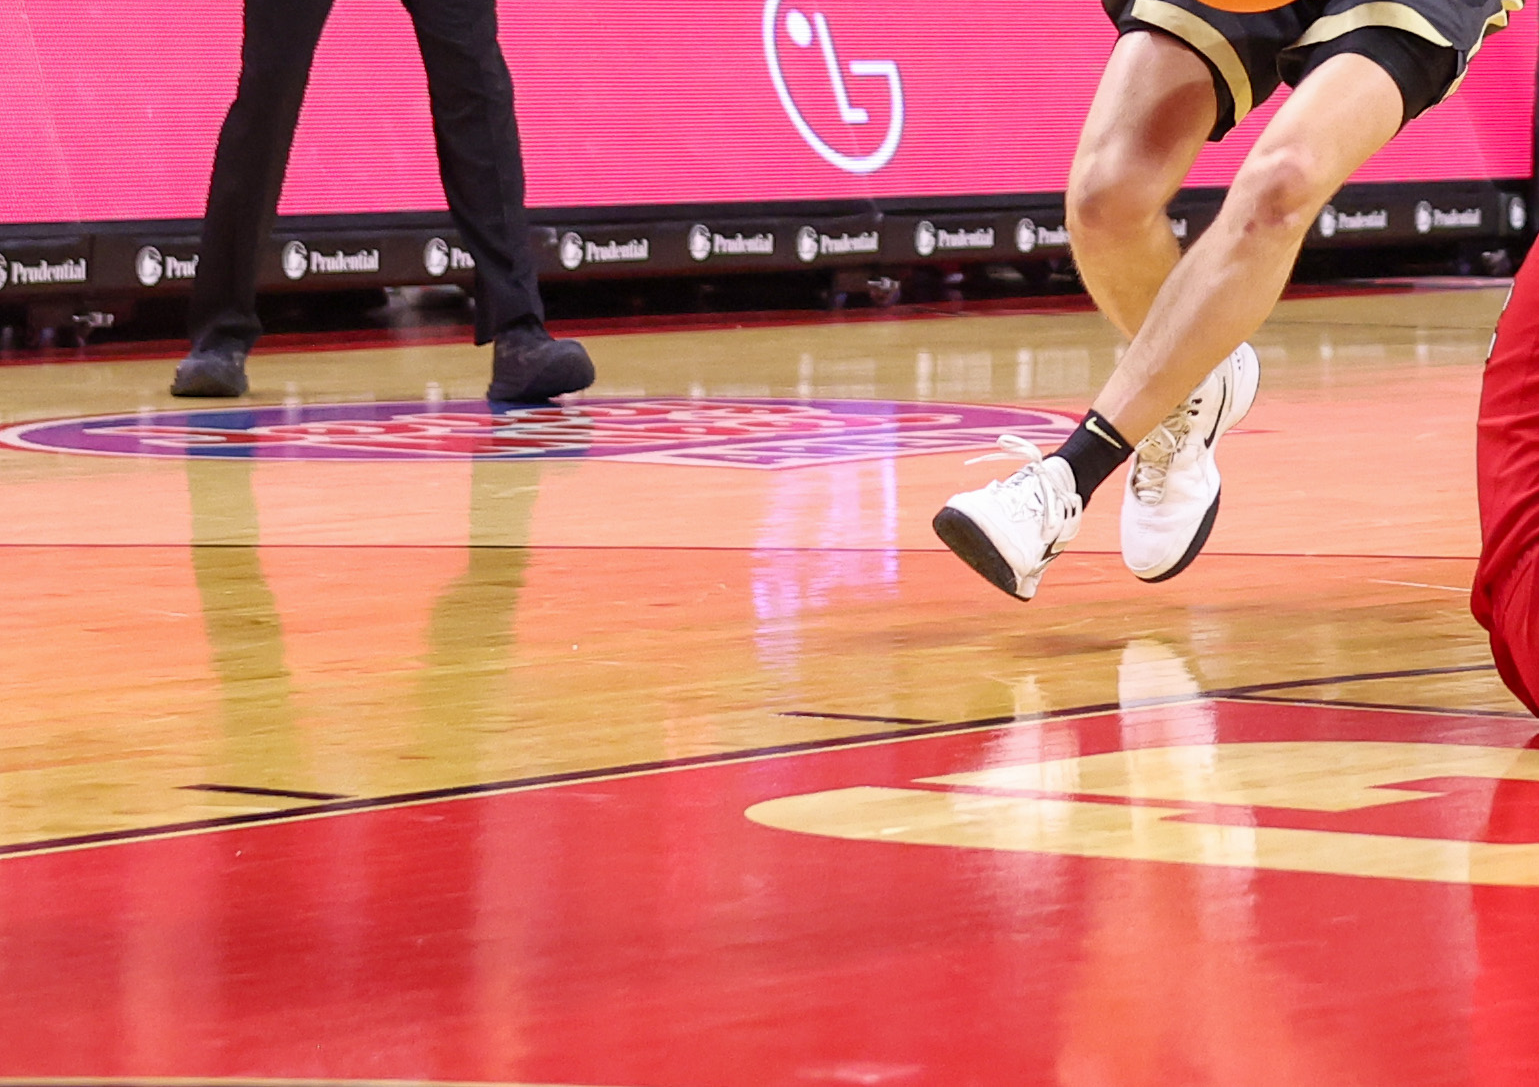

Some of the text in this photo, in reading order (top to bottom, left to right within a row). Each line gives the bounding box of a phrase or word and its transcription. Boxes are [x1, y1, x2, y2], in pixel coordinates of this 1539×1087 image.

[713, 233, 774, 255] Prudential
[819, 231, 880, 255] Prudential
[937, 226, 995, 249] Prudential
[310, 248, 380, 274] Prudential
[585, 238, 649, 263] Prudential
[10, 257, 88, 285] Prudential
